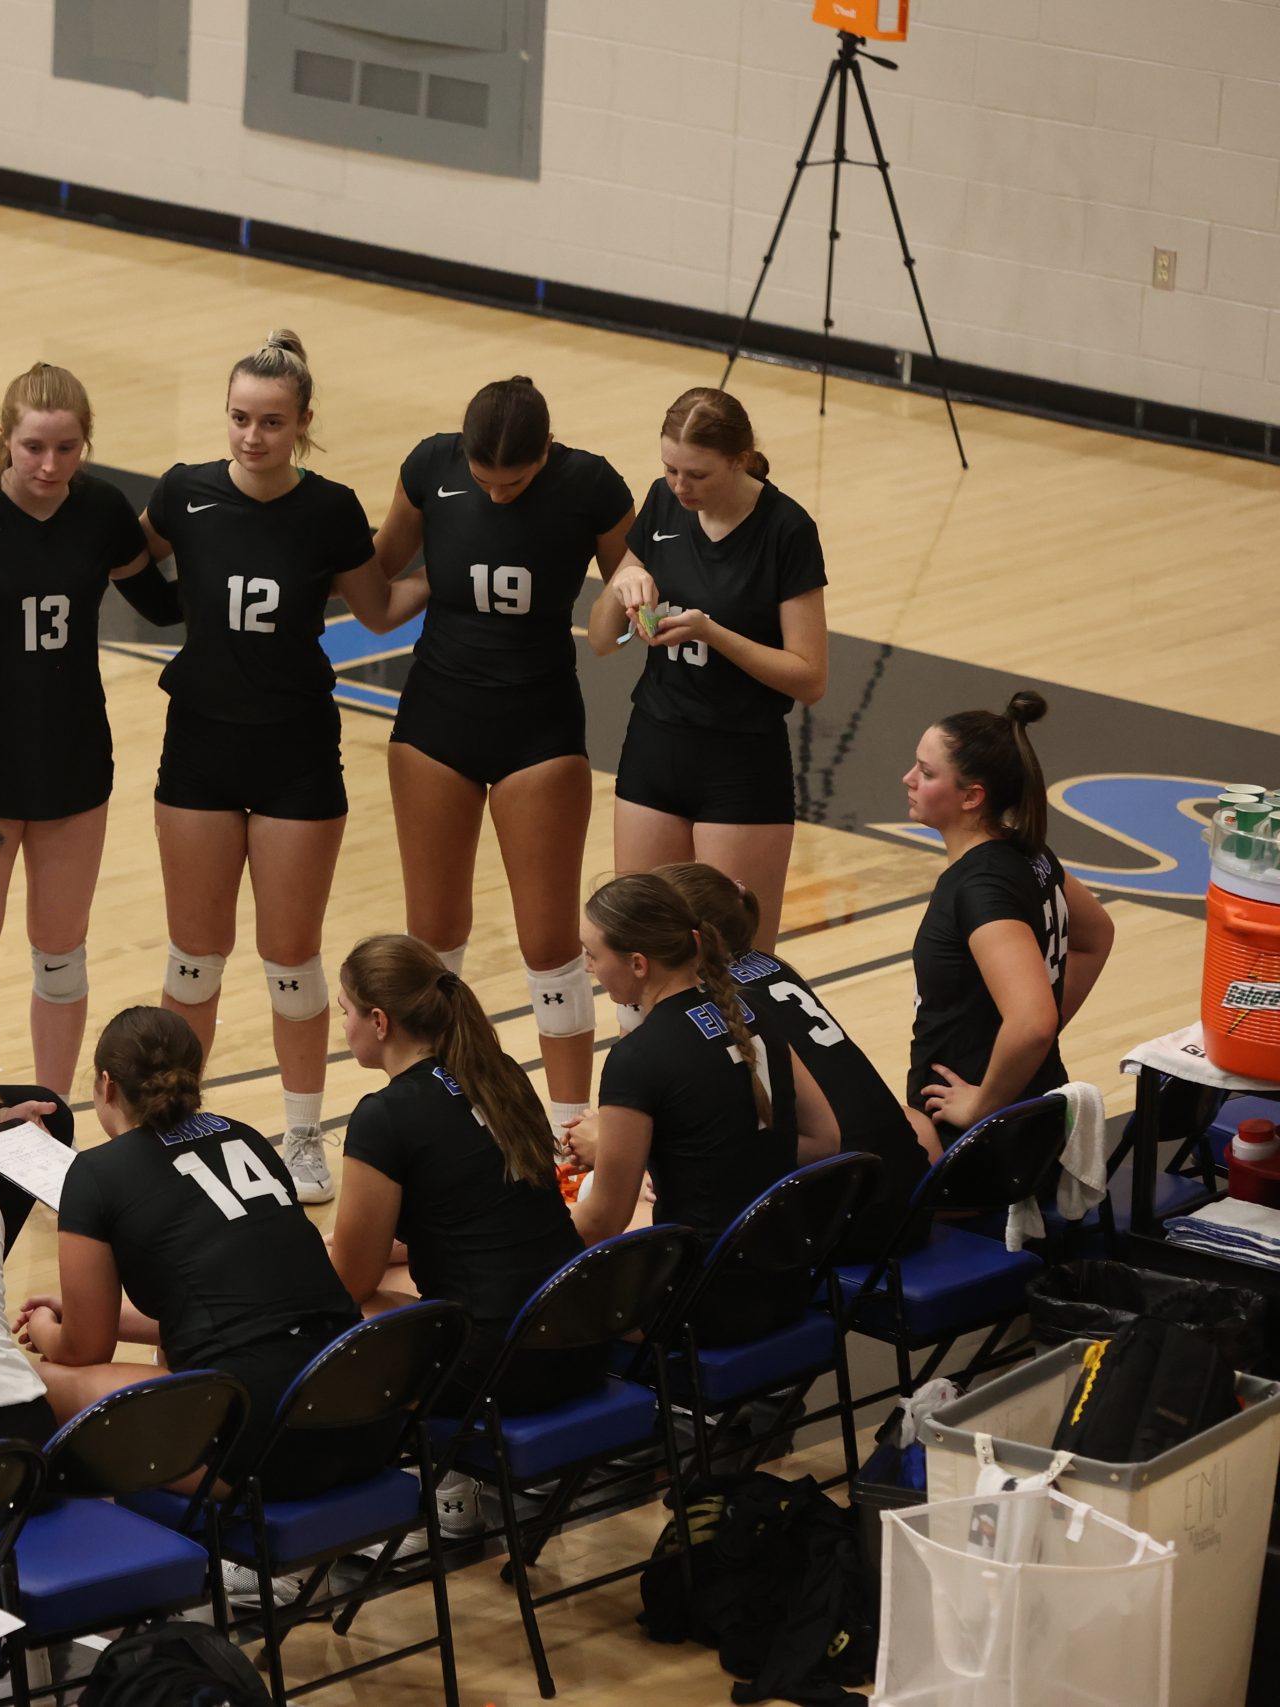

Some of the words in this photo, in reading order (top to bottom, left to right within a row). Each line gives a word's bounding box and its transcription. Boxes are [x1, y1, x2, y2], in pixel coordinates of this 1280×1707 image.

[227, 575, 280, 633] 12
[470, 563, 532, 615] 19
[21, 595, 70, 651] 13
[768, 980, 845, 1048] 3
[172, 1138, 293, 1221] 14
